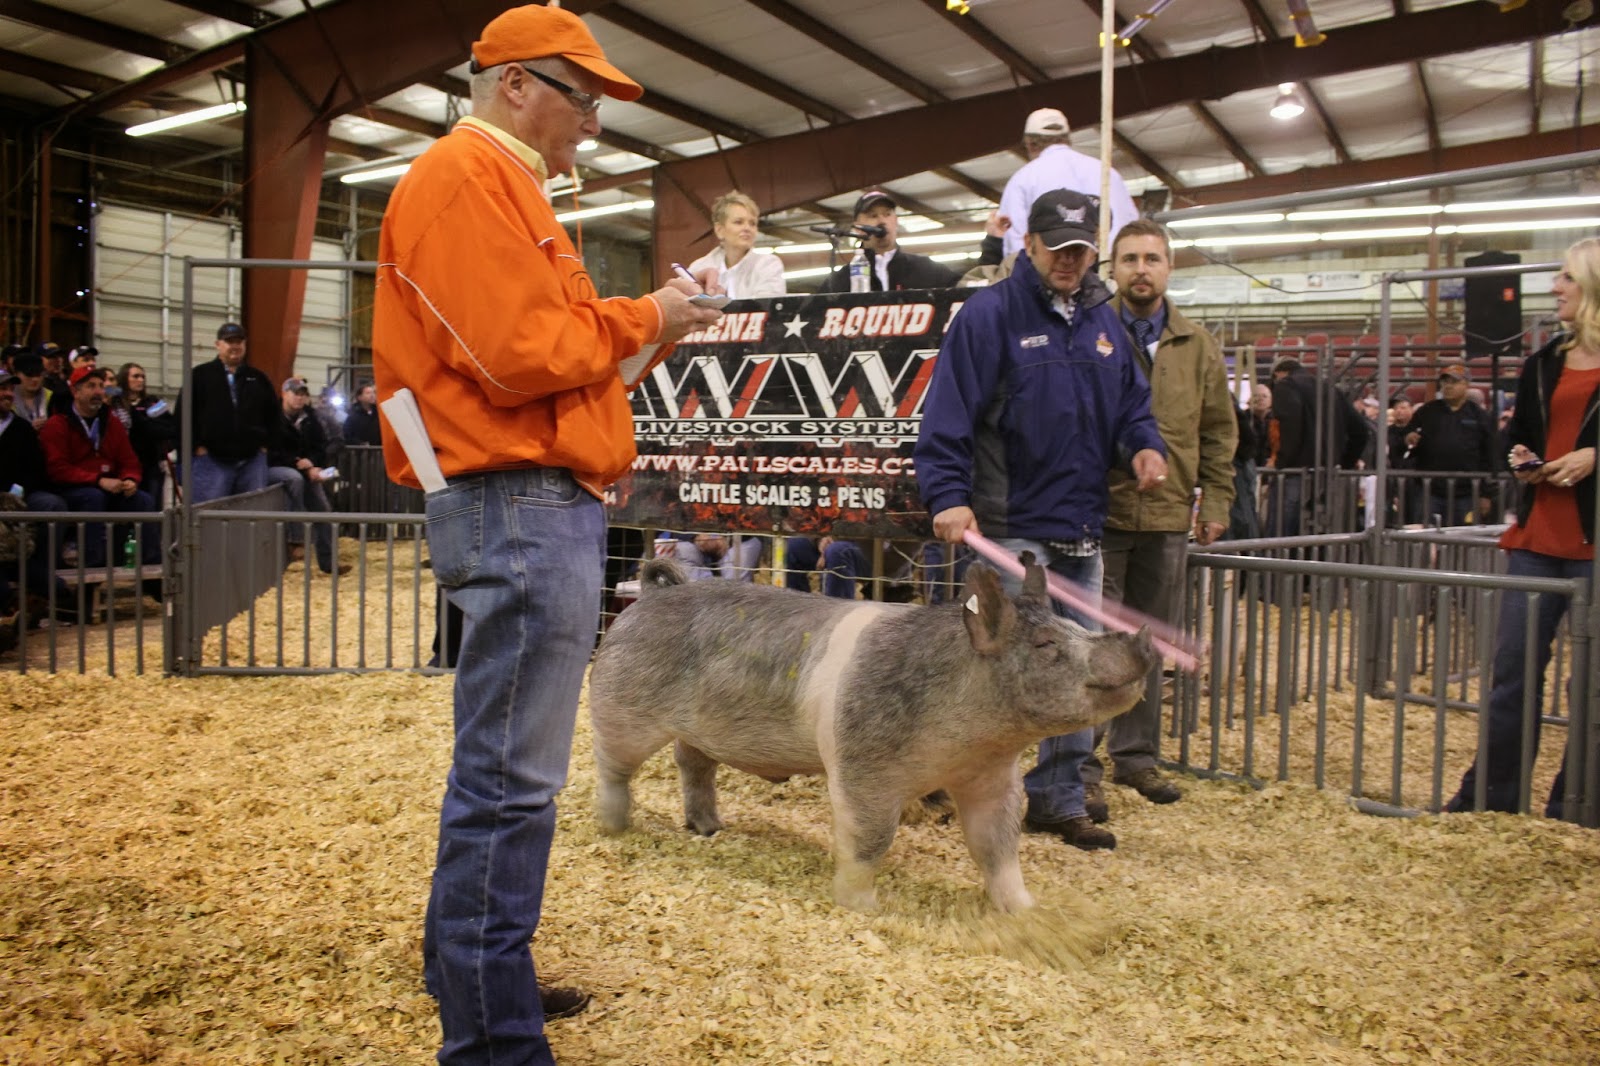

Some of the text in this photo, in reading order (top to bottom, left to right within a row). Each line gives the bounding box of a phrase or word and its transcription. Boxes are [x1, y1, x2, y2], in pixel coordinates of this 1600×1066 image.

[675, 311, 768, 344] ENA
[818, 303, 935, 339] ROUND
[634, 421, 791, 434] LIVESTOCK
[679, 483, 886, 509] CATTLE SCALES & PENS
